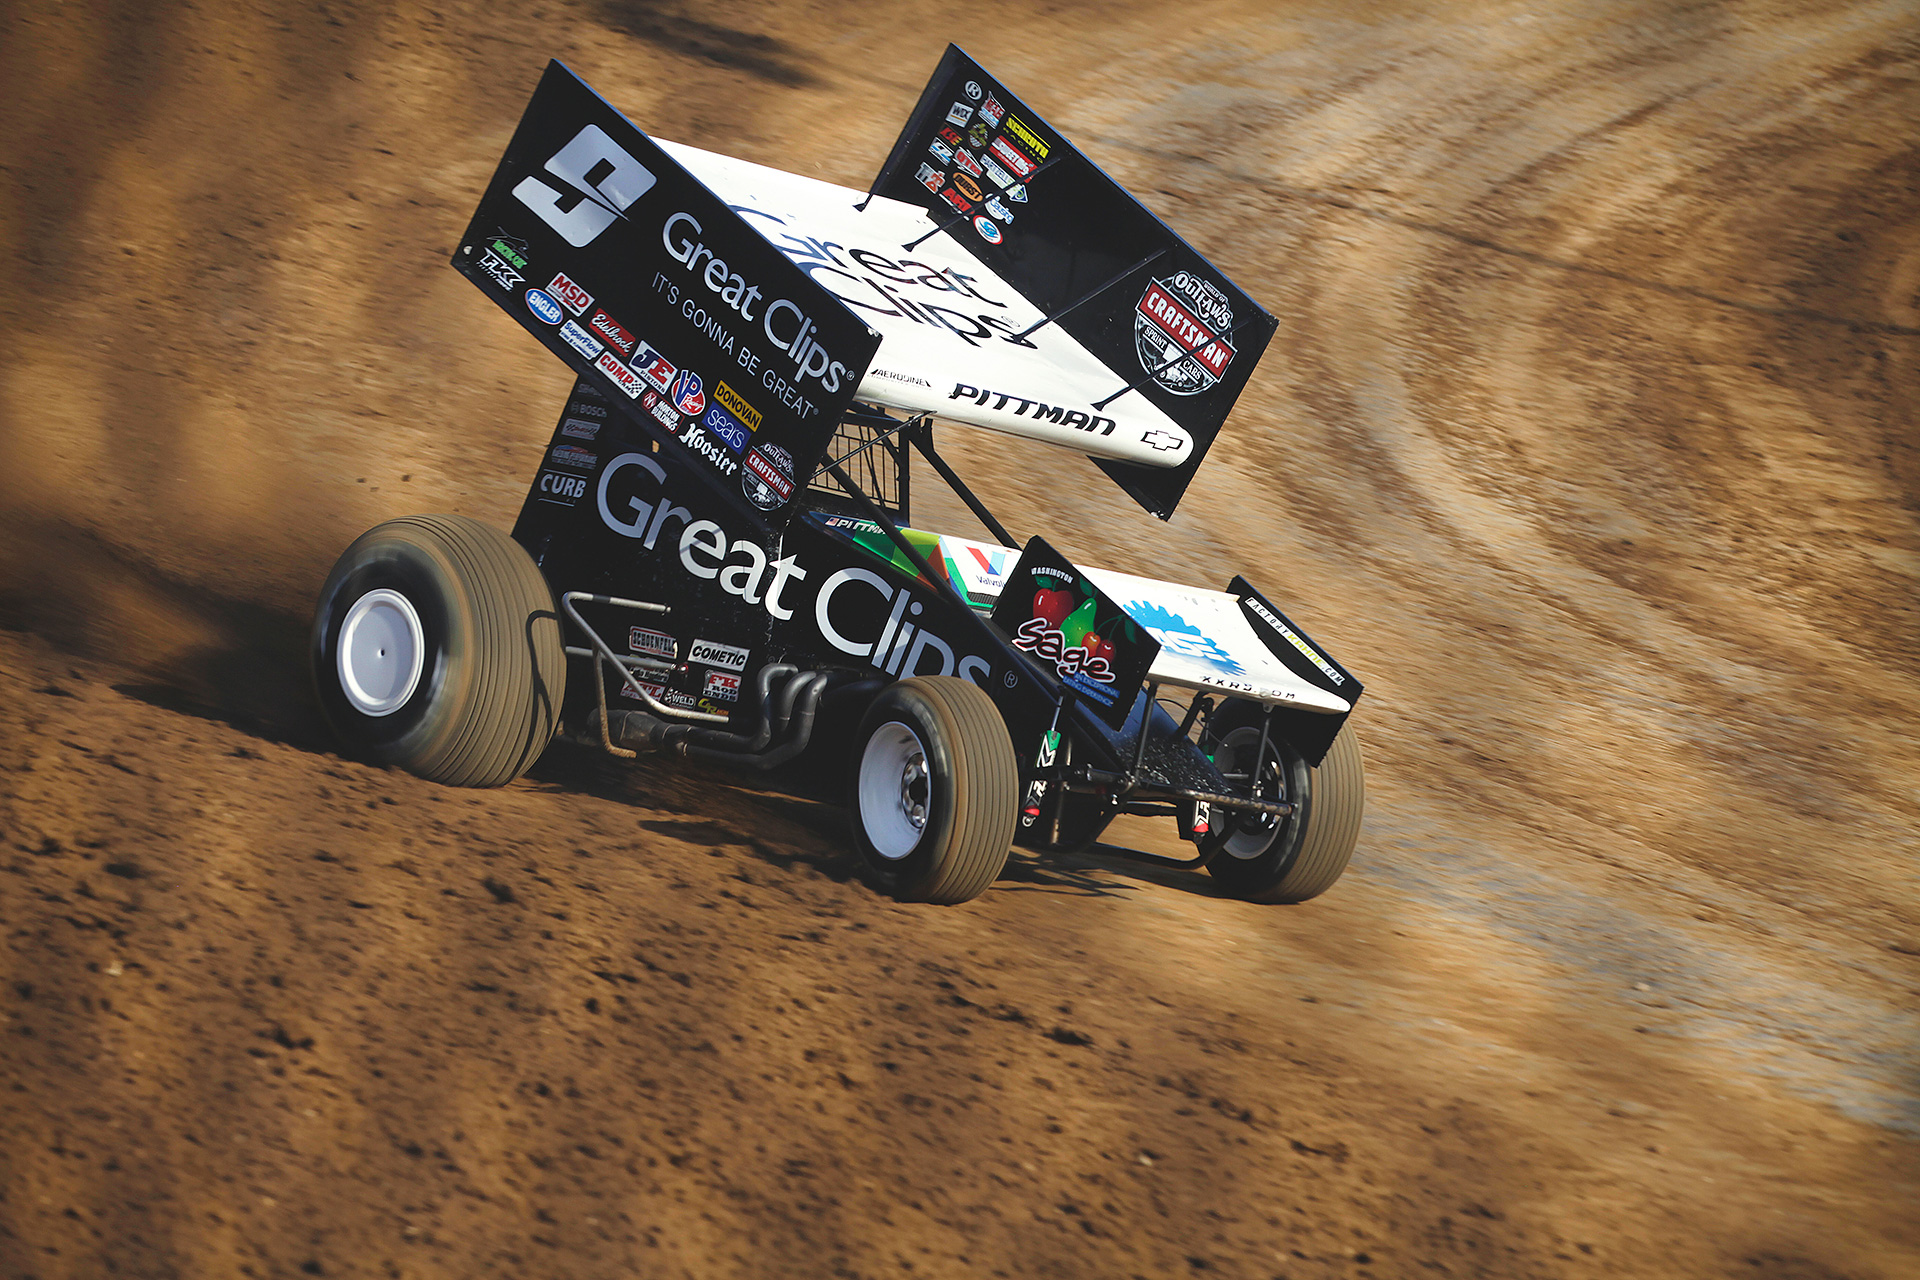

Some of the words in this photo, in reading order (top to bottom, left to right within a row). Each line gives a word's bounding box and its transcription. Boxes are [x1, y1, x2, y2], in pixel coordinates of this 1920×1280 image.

[952, 104, 970, 119] WIX
[511, 123, 658, 248] 9
[726, 204, 1008, 308] Great
[528, 291, 561, 322] ENGLER
[552, 275, 590, 308] MSD
[662, 211, 762, 322] Great
[763, 299, 846, 395] Clips
[796, 262, 1038, 349] Clips
[564, 322, 600, 355] SuperFlow
[591, 313, 633, 353] Edelbrock
[652, 271, 679, 304] IT'S
[681, 297, 734, 356] GONNA
[737, 344, 762, 376] BE
[762, 364, 814, 420] GREAT
[1147, 292, 1225, 368] CRAFTSMAN
[600, 354, 634, 385] COMP
[631, 349, 675, 385] JE
[1144, 326, 1167, 349] SPRINT
[1183, 360, 1202, 380] CARS
[640, 369, 666, 394] PISTONS
[674, 370, 702, 407] VP
[580, 404, 607, 418] BOSCH
[651, 406, 678, 431] BUILDINGS
[657, 400, 680, 422] MORTON
[717, 384, 760, 428] DONOVAN
[950, 383, 1116, 436] PITTMAN
[707, 409, 745, 448] sears
[678, 423, 738, 476] Hoosier
[540, 473, 587, 499] CURB
[748, 454, 791, 495] CRAFTSMAN
[597, 452, 808, 622] Great
[836, 519, 886, 535] PITTMA
[1030, 566, 1074, 584] WASHINGTON
[632, 630, 674, 653] SCHOENFEL
[692, 645, 746, 666] COMETIC
[703, 690, 737, 701] ENDS
[709, 674, 739, 689] FK
[712, 685, 738, 695] ROD
[672, 693, 695, 706] WELD
